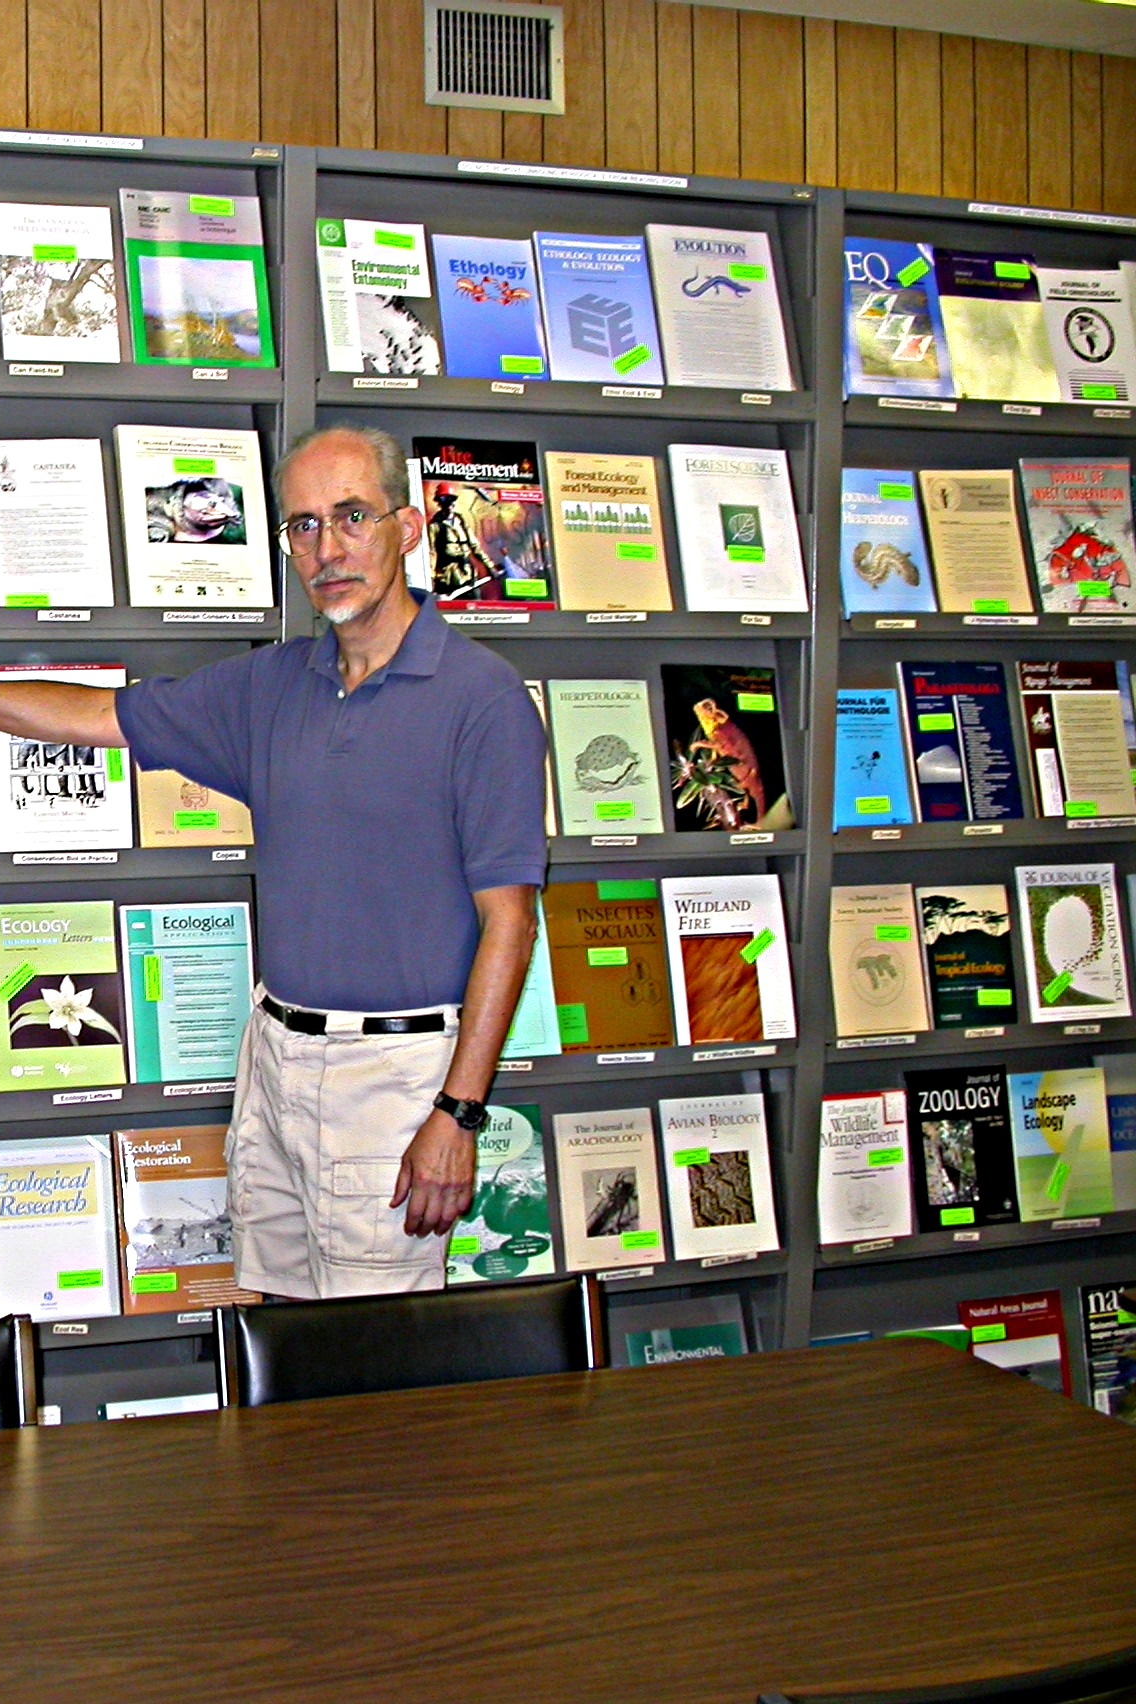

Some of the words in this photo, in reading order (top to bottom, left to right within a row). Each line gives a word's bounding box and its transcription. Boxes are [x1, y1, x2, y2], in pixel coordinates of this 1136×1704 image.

[673, 239, 746, 255] EVOLUTION
[597, 252, 642, 263] ECOLOGY
[351, 259, 420, 276] Environmental
[449, 259, 526, 280] Ethology
[571, 261, 625, 271] EVOLUTION
[844, 251, 891, 290] EQ
[353, 273, 407, 289] Entomology
[440, 445, 472, 464] Fire
[423, 457, 519, 480] Management
[685, 458, 731, 473] FOREST
[565, 468, 598, 482] Forest
[598, 470, 639, 485] Ecology
[1050, 471, 1087, 485] JOURNAL
[1090, 472, 1103, 483] OF
[561, 482, 580, 493] and
[581, 482, 647, 498] Management
[1032, 489, 1060, 500] INSECT
[1065, 488, 1124, 501] CONSERVATION
[48, 612, 81, 620] Castanea
[201, 612, 230, 620] Conserv
[238, 613, 264, 622] Biology
[1022, 663, 1051, 673] Journal
[1050, 677, 1092, 688] Management
[560, 691, 641, 701] HERPETOLOGICA
[216, 852, 239, 860] Copeia
[1040, 872, 1085, 883] JOURNAL
[1087, 871, 1099, 882] OF
[577, 906, 654, 922] INSECTES
[675, 899, 751, 914] WILDLAND
[0, 917, 71, 934] ECOLOGY
[162, 915, 234, 930] Ecological
[678, 917, 711, 930] FIRE
[62, 934, 93, 944] Letters
[584, 923, 656, 940] SOCIAUX
[966, 1074, 991, 1084] Journal
[992, 1073, 1000, 1082] of
[60, 1094, 88, 1102] Ecology
[918, 1087, 1001, 1113] ZOOLOGY
[1023, 1092, 1076, 1110] Landscape
[827, 1105, 840, 1115] The
[842, 1104, 865, 1115] Journal
[867, 1101, 879, 1113] of
[575, 1125, 589, 1134] The
[592, 1123, 624, 1133] Journal
[626, 1122, 634, 1130] of
[667, 1117, 706, 1129] AVIAN
[709, 1114, 762, 1127] BIOLOGY
[830, 1115, 879, 1132] Wildlife
[1024, 1114, 1064, 1130] Ecology
[124, 1139, 182, 1155] Ecological
[568, 1134, 643, 1148] ARACHNOLOGY
[820, 1131, 898, 1148] Management
[126, 1154, 191, 1168] Restoration
[645, 1344, 725, 1364] ENVIRONMENTAL
